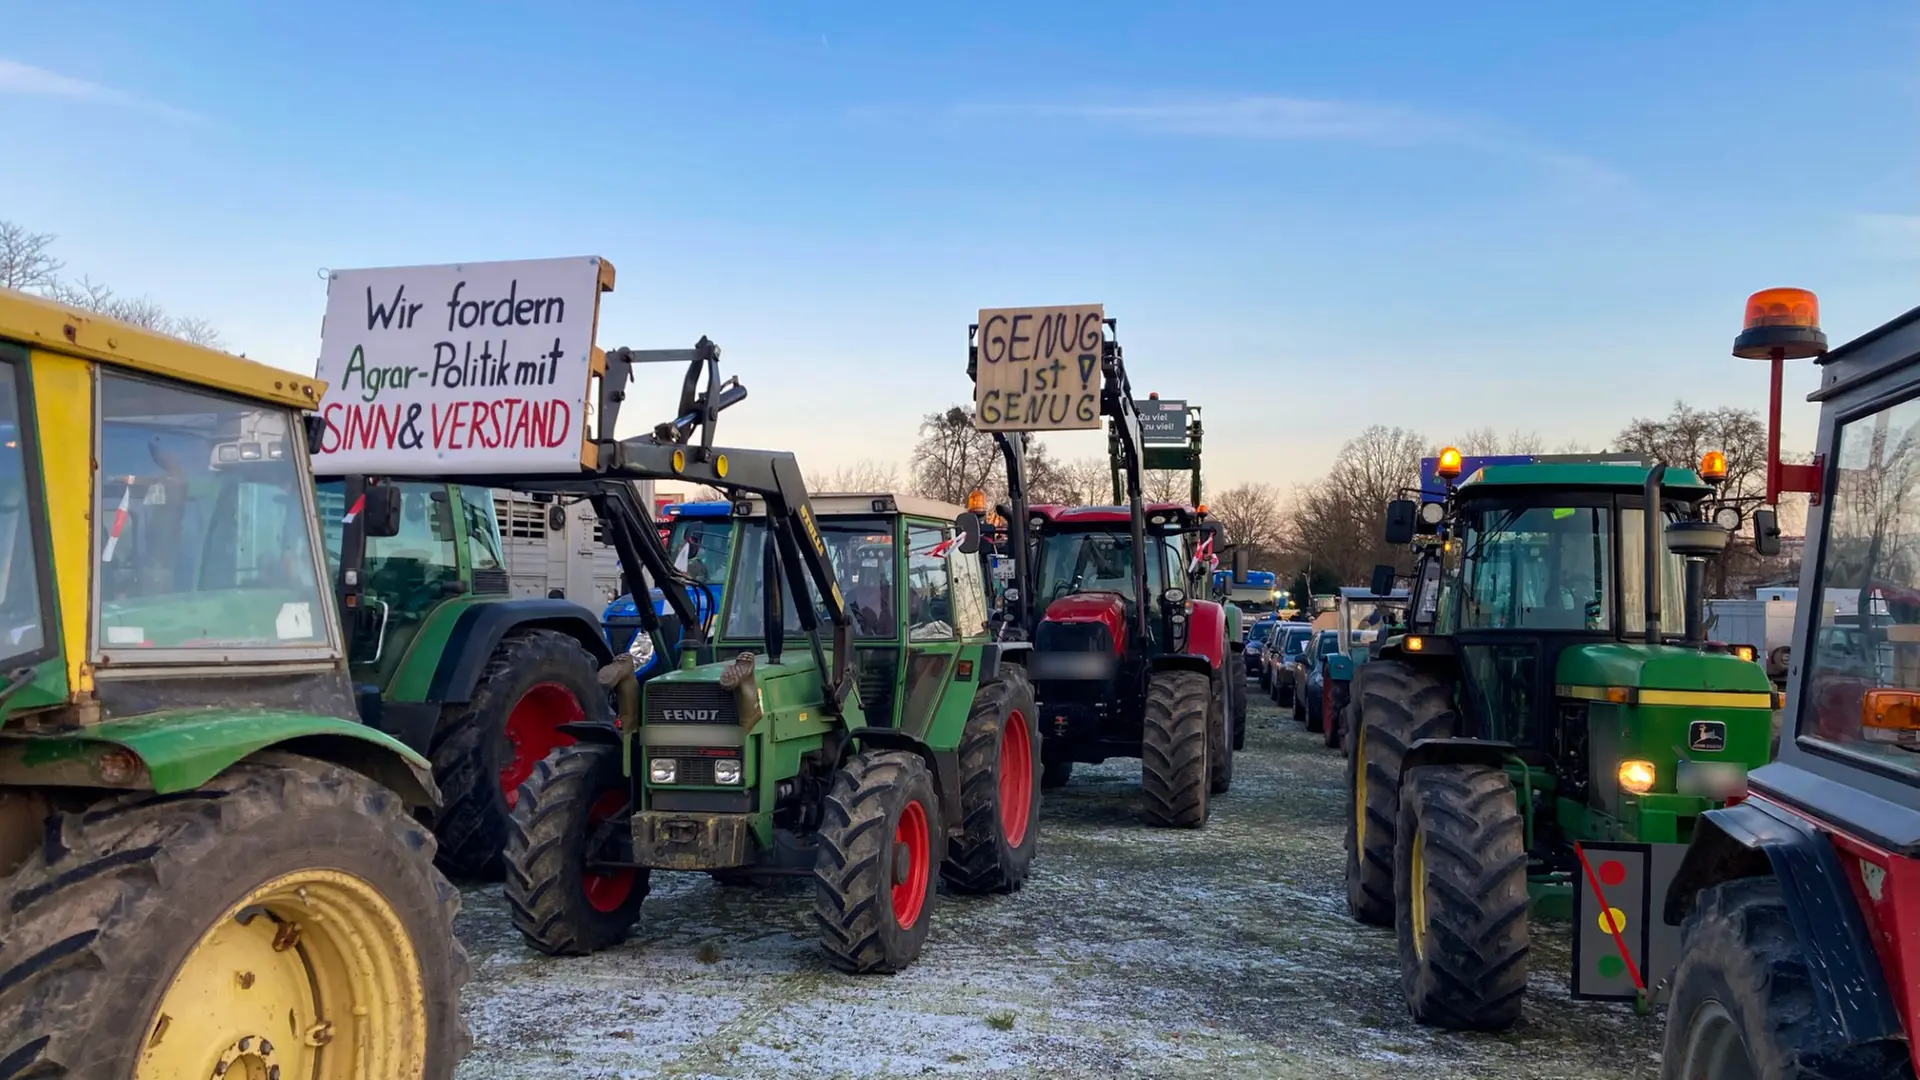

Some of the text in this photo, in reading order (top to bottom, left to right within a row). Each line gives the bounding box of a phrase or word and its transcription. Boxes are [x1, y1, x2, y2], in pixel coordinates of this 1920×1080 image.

[366, 279, 565, 331] Wir fordern
[982, 312, 1100, 364] GENUG
[431, 399, 571, 450] VERSTAND
[980, 390, 1095, 425] GENUG
[1152, 413, 1168, 421] viel
[663, 709, 720, 721] FENDT
